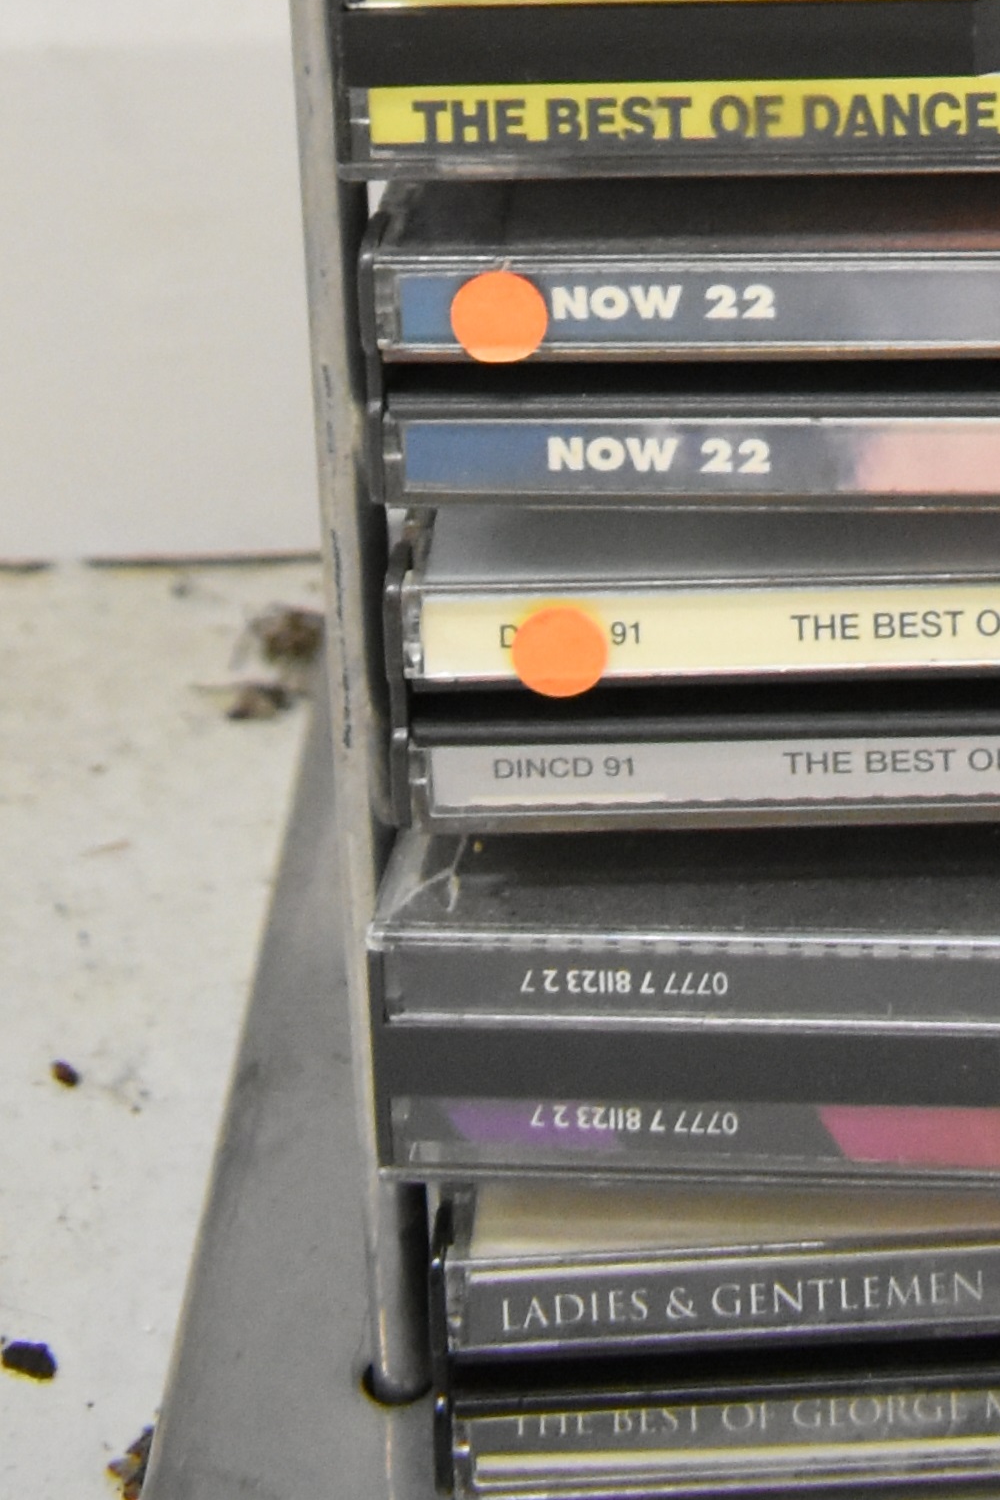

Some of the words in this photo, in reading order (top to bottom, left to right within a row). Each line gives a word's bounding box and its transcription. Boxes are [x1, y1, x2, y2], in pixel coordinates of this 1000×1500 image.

[552, 284, 684, 321] NOW
[703, 283, 778, 320] 22
[546, 436, 679, 472] NOW
[699, 438, 771, 473] 22
[791, 613, 862, 643] THE
[873, 610, 965, 640] BEST
[492, 756, 594, 781] DINCD
[602, 754, 636, 778] 91
[500, 1290, 651, 1332] LADIES
[710, 1269, 985, 1317] GENTLEMEN
